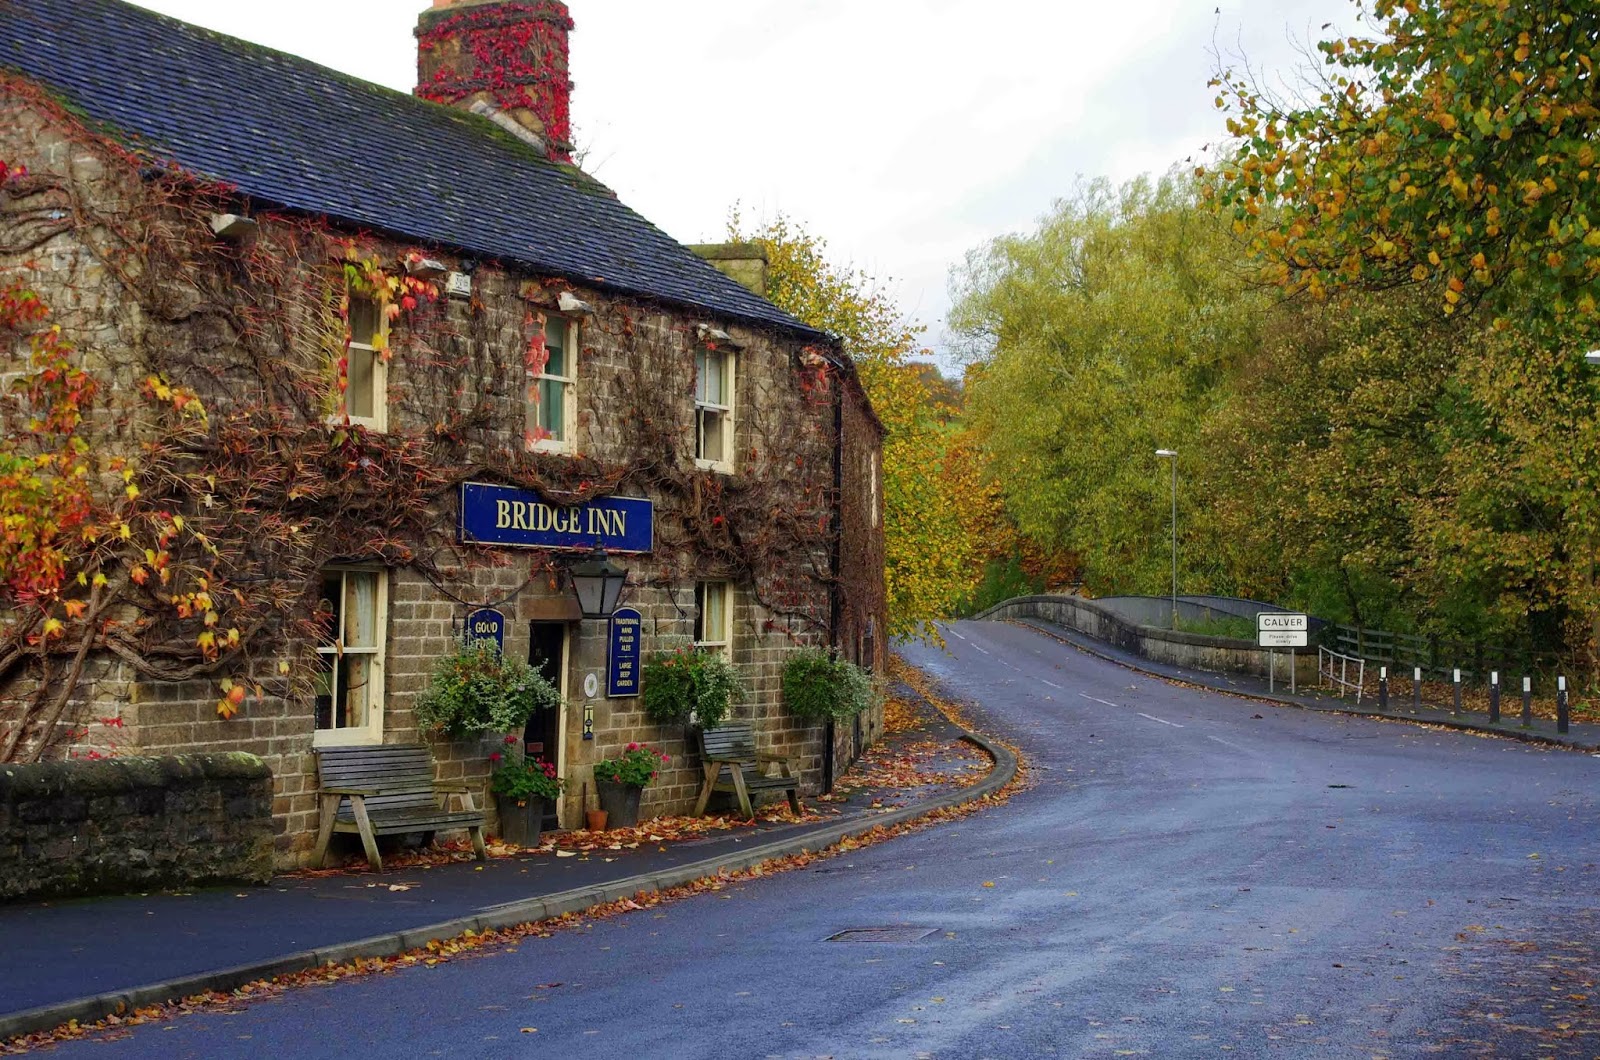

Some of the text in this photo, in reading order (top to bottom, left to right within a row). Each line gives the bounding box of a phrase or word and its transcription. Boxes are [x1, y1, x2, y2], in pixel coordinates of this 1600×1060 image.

[495, 499, 627, 537] BRIDGE INN
[475, 621, 498, 634] GOOD
